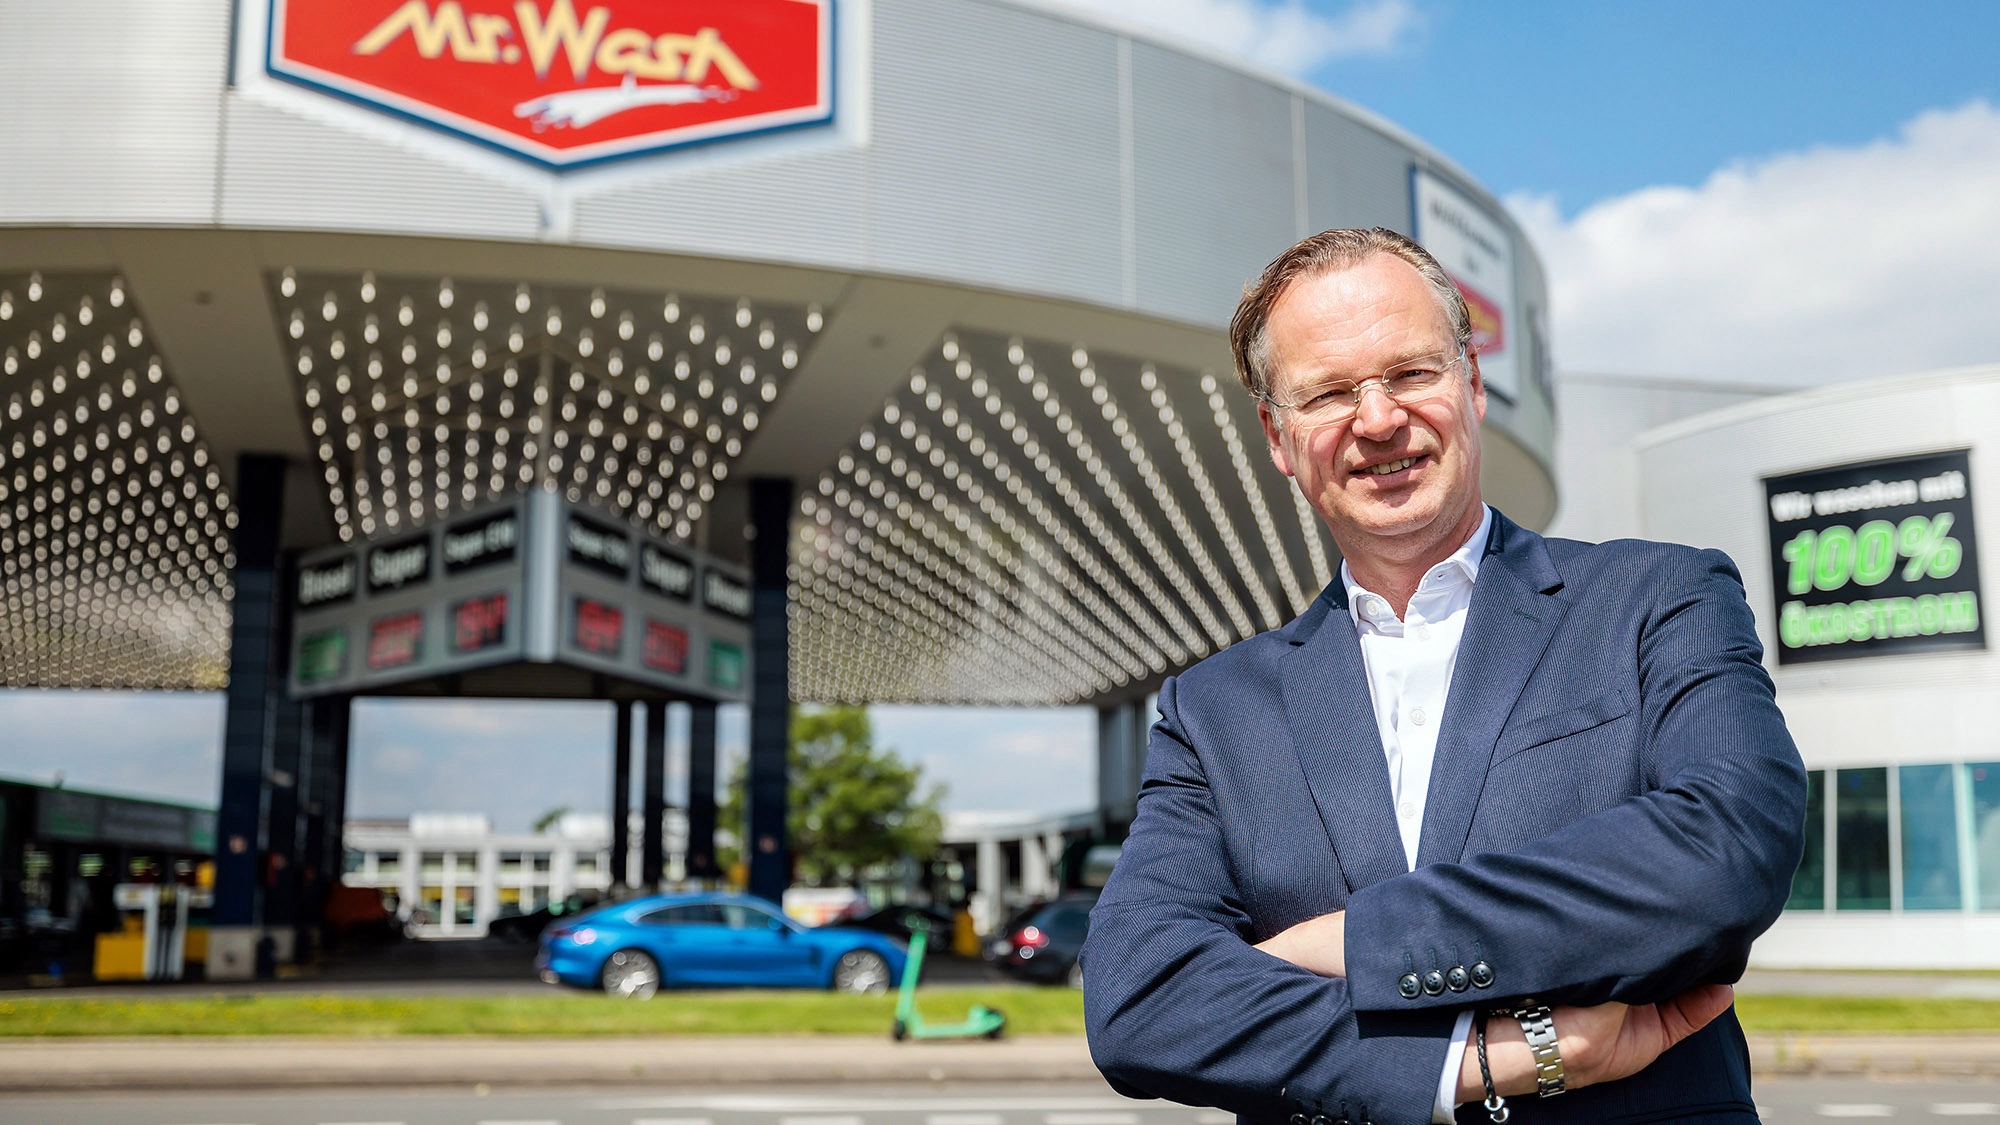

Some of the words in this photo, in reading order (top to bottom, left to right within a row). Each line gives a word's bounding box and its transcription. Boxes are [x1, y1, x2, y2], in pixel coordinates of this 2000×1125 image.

[1918, 470, 1966, 502] mit
[1782, 512, 1963, 596] 100%
[1779, 590, 1979, 648] ÖKOSTROM
